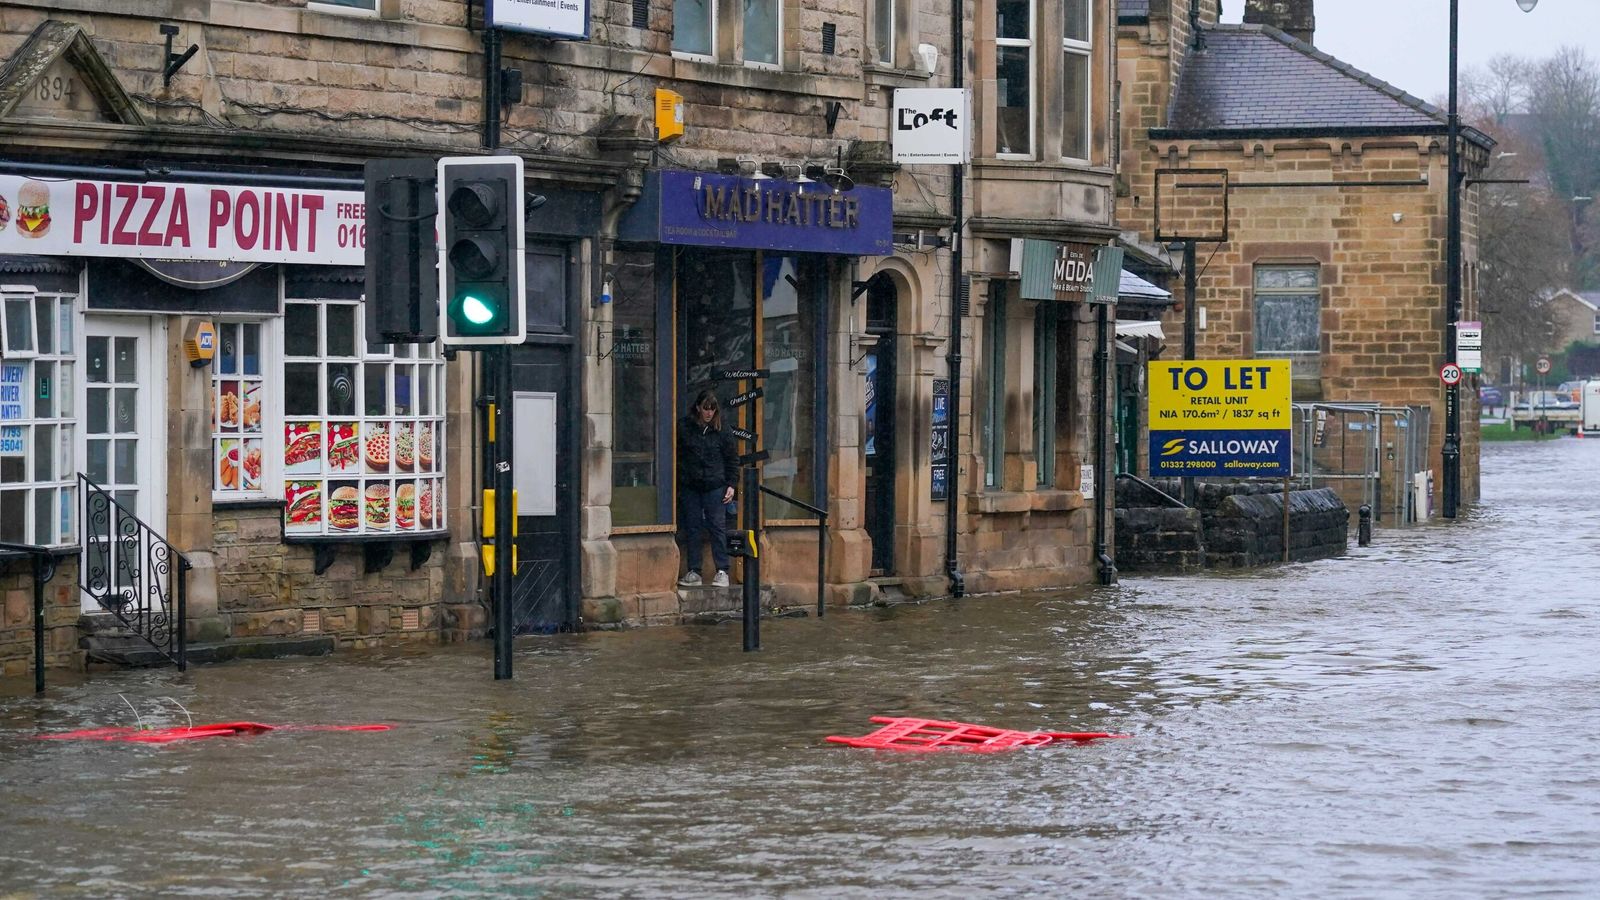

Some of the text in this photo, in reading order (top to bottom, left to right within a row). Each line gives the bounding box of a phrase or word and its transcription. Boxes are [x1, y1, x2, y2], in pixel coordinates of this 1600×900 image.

[560, 2, 579, 11] Events
[34, 76, 76, 101] 1894
[898, 108, 958, 131] Loft
[73, 182, 325, 253] PIZZA POINT
[336, 202, 366, 220] FREE
[1053, 259, 1094, 283] MODA
[621, 343, 650, 353] HATTER
[724, 370, 759, 378] welcome
[1168, 366, 1272, 391] TO LET
[1443, 369, 1459, 379] 20
[1190, 396, 1248, 405] RETAIL UNIT
[1159, 410, 1178, 418] NIA
[1182, 409, 1220, 419] 170.6m²
[1233, 409, 1254, 418] 1837
[1258, 411, 1269, 420] sq
[1272, 408, 1281, 418] ft
[1188, 440, 1280, 455] SALLOWAY
[1160, 460, 1280, 471] 01332 298000 salloway.com
